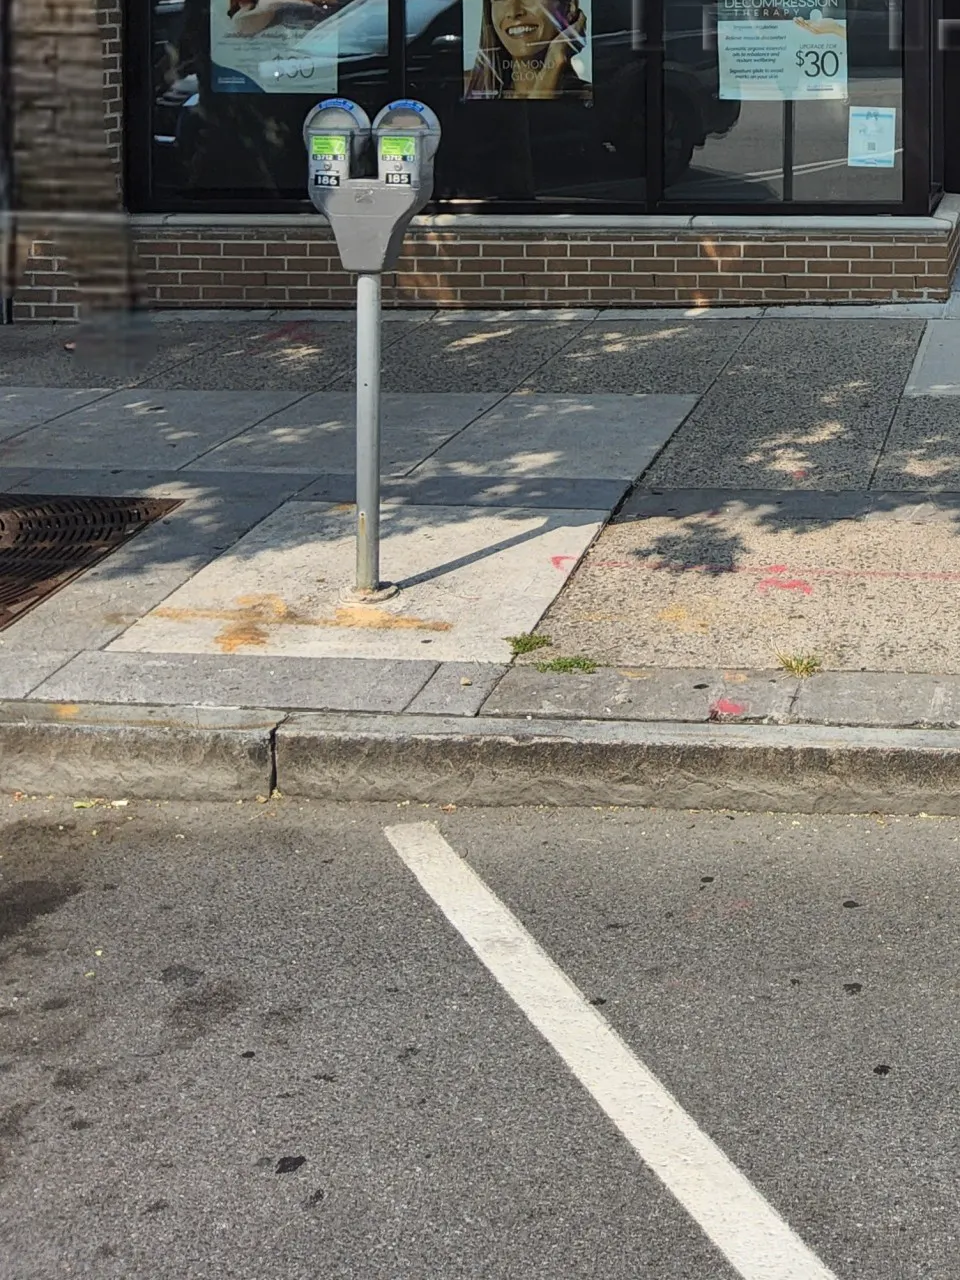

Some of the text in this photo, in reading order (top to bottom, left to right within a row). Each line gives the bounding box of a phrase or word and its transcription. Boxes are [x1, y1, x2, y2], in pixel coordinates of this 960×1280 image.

[734, 9, 800, 17] THERAPY
[502, 59, 556, 70] DIAMOND
[511, 71, 545, 82] GLOW
[317, 175, 338, 186] 186
[387, 174, 409, 184] 185
